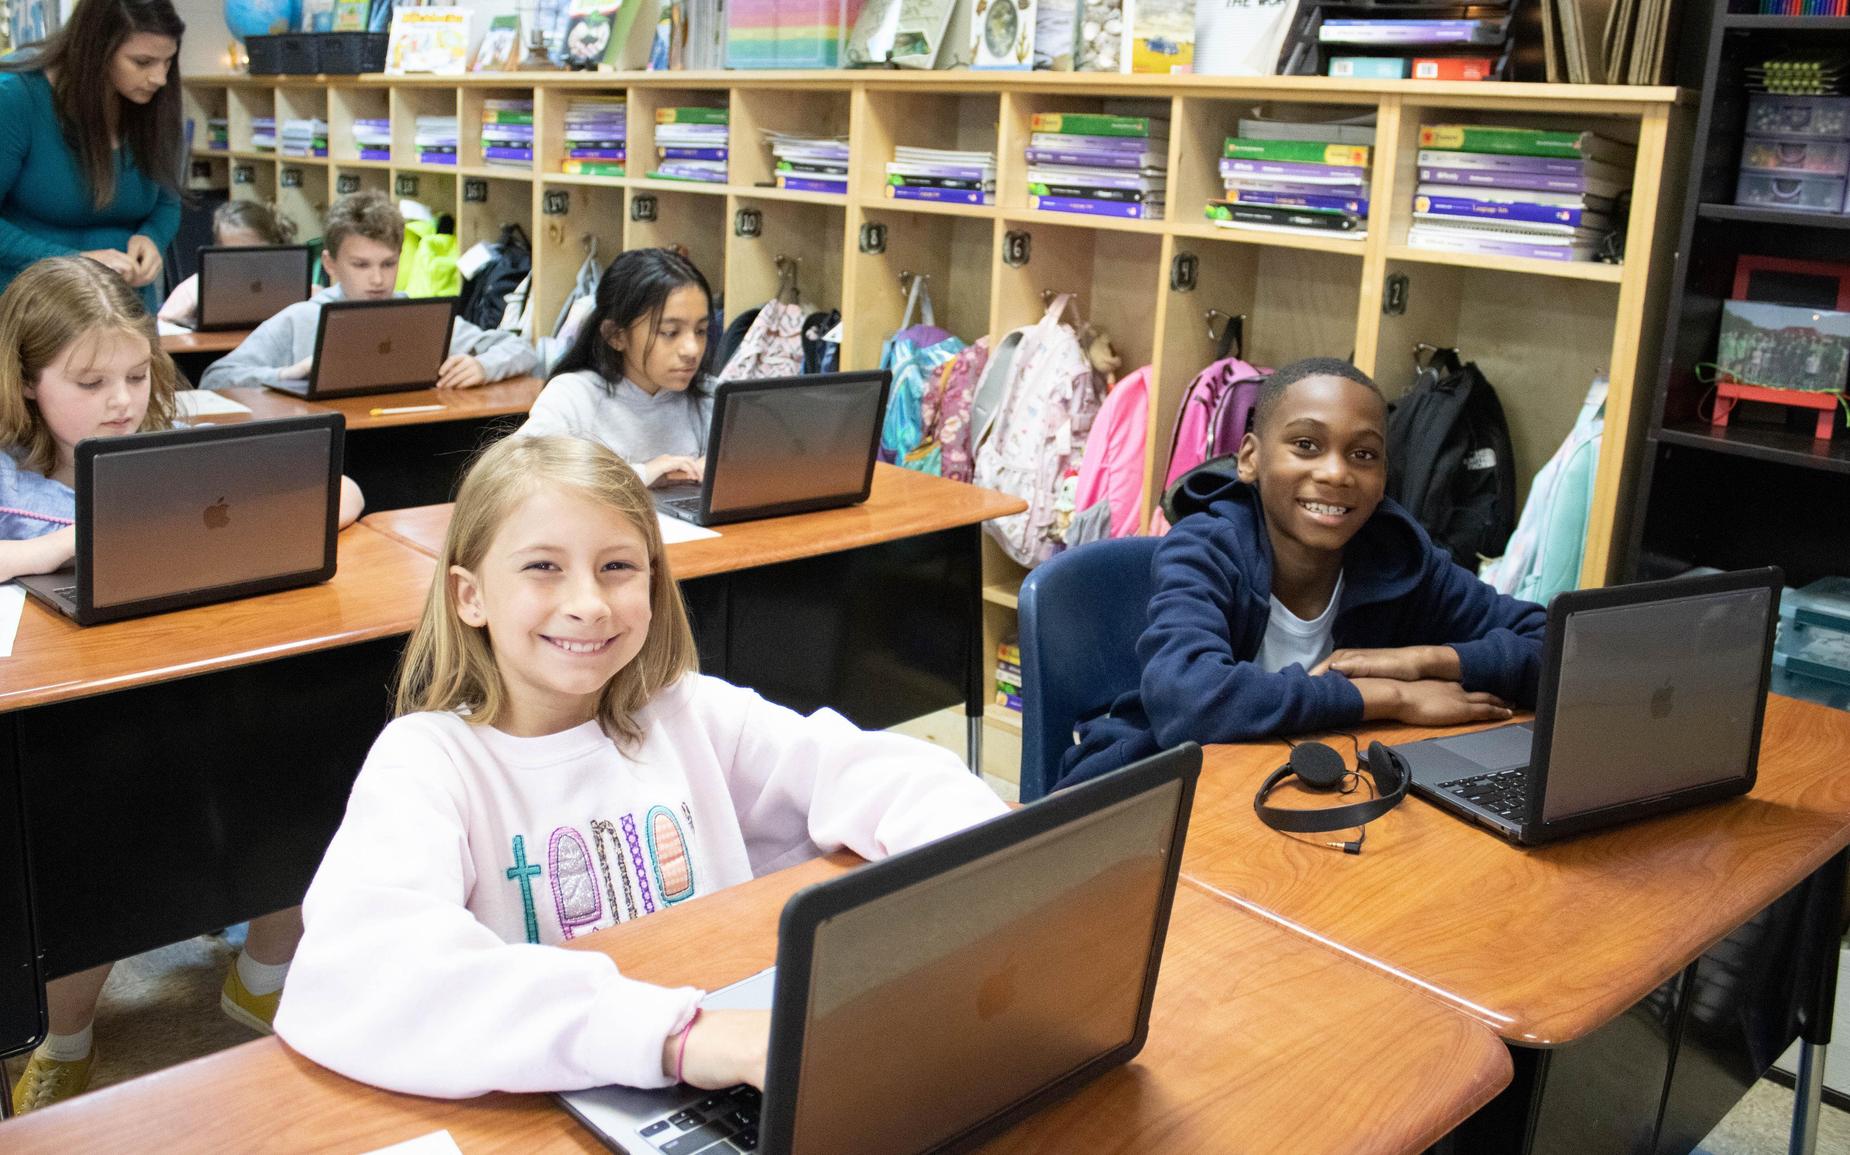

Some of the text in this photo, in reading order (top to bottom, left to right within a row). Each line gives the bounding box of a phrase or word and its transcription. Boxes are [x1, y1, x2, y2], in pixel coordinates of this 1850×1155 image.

[639, 200, 650, 216] 12
[743, 214, 755, 231] 10
[870, 228, 878, 246] 8
[1013, 239, 1022, 257] 6
[1391, 283, 1401, 304] 2
